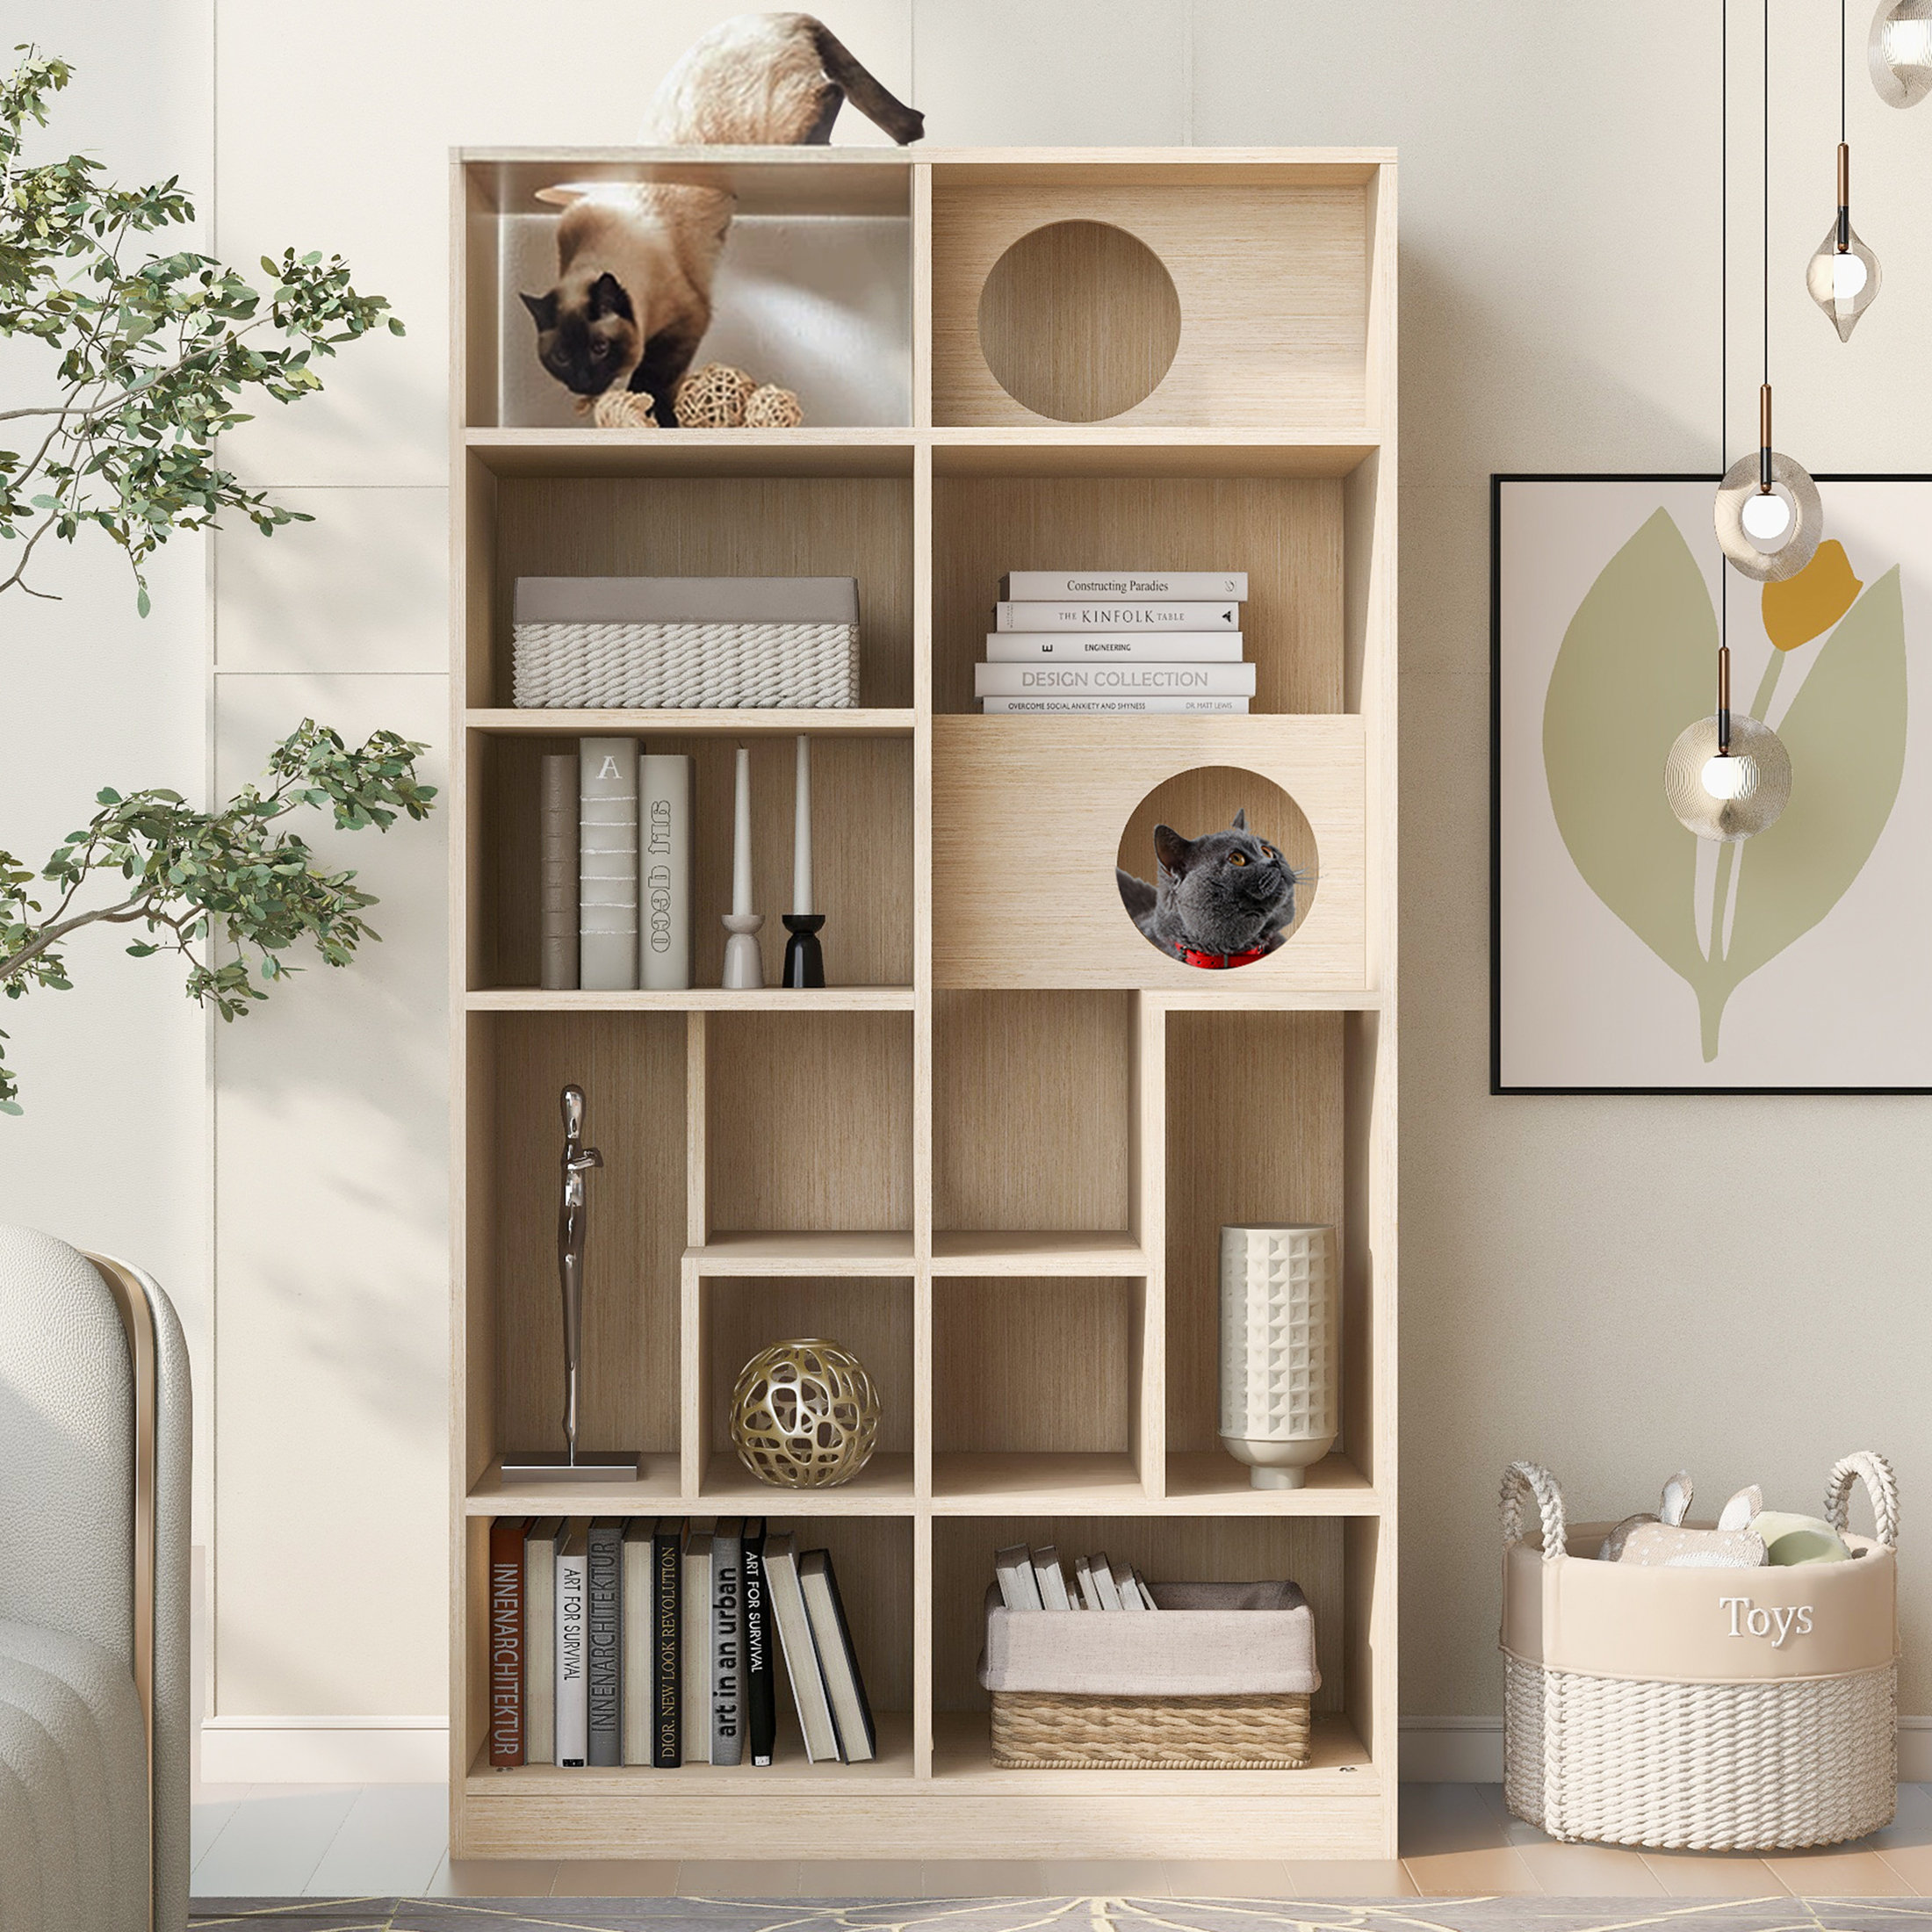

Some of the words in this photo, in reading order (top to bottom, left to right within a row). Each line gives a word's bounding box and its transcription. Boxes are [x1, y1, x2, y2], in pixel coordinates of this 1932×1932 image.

[1067, 580, 1127, 595] Constructing
[1129, 580, 1169, 592] Paradies
[1082, 609, 1155, 624] KINFOLK
[1022, 672, 1088, 687] DESIGN
[1094, 672, 1208, 687] COLLECTION
[596, 755, 623, 779] A
[564, 1568, 581, 1591] ART
[746, 1551, 759, 1576] ART
[662, 1546, 675, 1637] REVOLUTION
[712, 1568, 737, 1635] urban
[747, 1582, 760, 1609] FOR
[564, 1597, 580, 1621] FOR
[1719, 1597, 1814, 1647] Toys
[564, 1626, 580, 1681] SURVIVAL
[591, 1542, 616, 1733] INNENARCHITEKTUR
[748, 1612, 763, 1673] SURVIVAL
[494, 1563, 519, 1755] INNENARCHITEKTUR
[662, 1642, 675, 1681] LOOK
[718, 1641, 737, 1669] an
[662, 1685, 675, 1717] NEW
[712, 1676, 737, 1697] in
[715, 1705, 737, 1737] art
[662, 1719, 675, 1758] DIOR.
